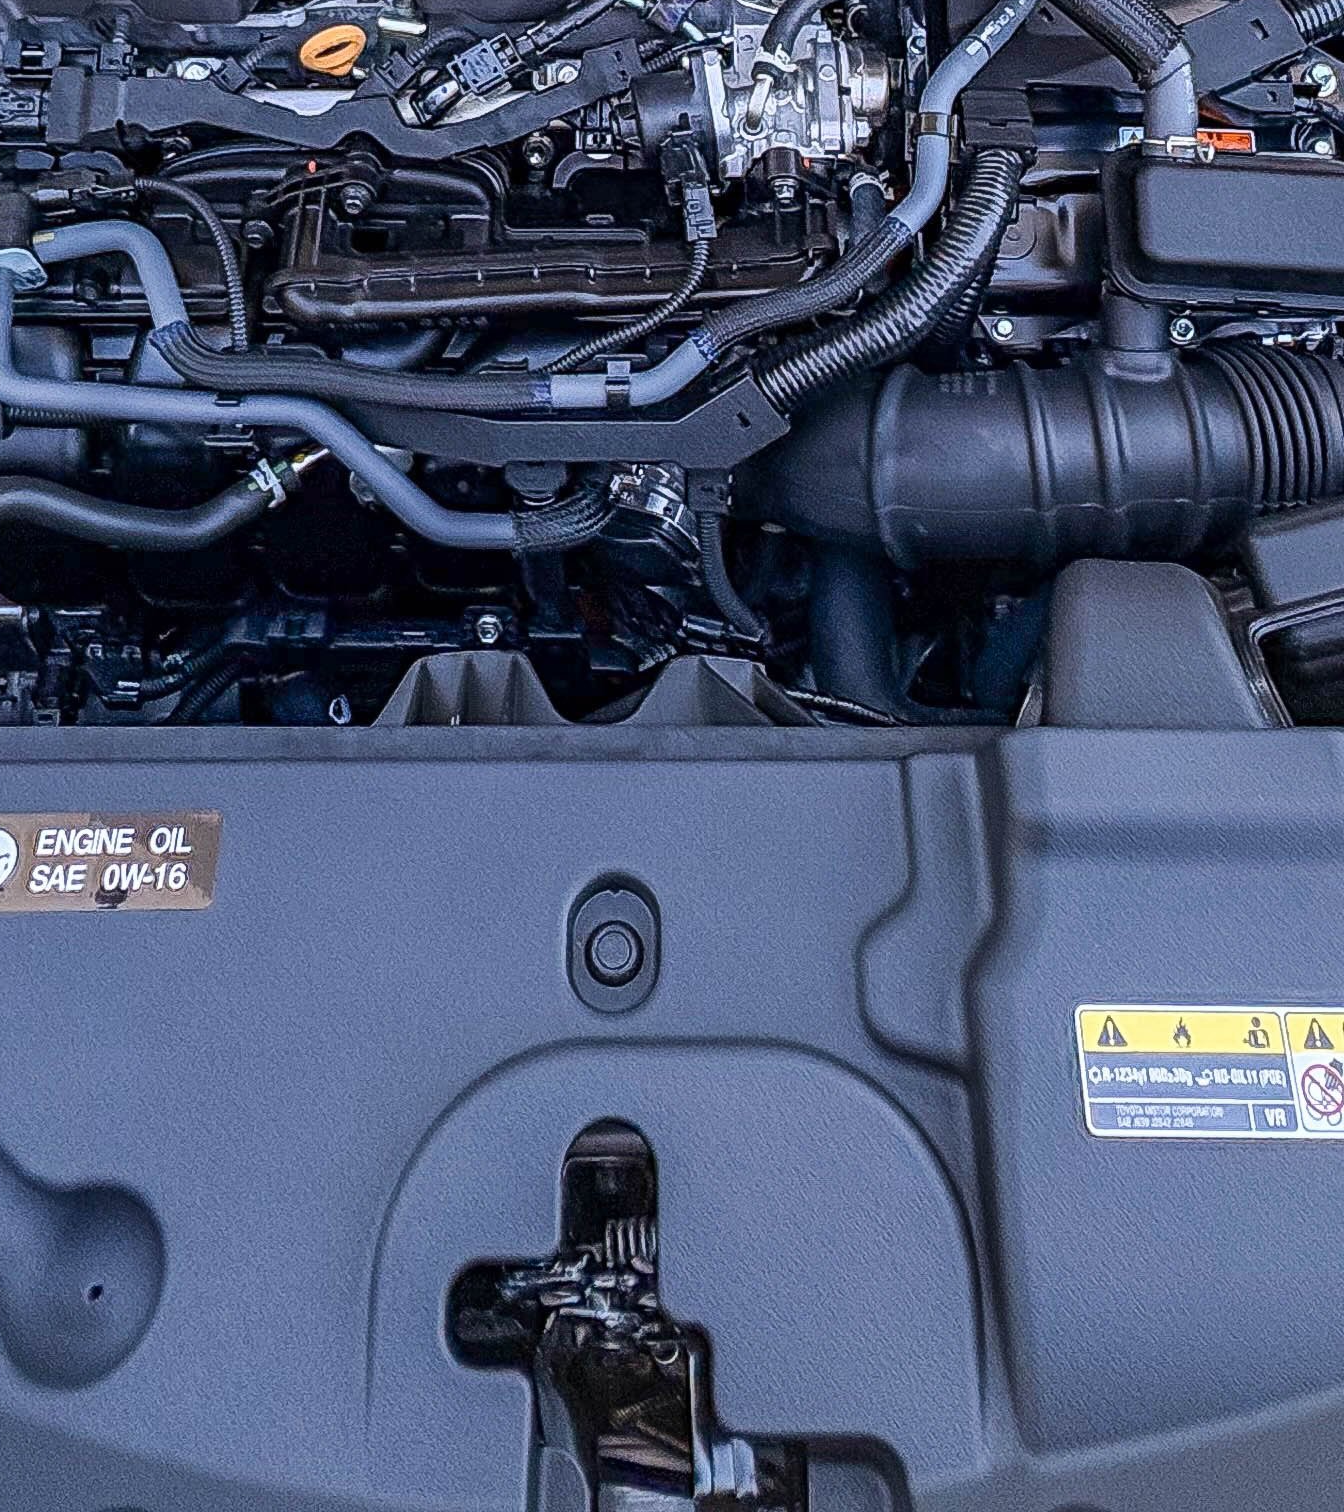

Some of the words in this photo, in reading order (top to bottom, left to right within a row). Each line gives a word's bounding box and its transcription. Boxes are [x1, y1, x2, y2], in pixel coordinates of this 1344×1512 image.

[35, 827, 137, 857] ENGINE
[149, 826, 193, 855] OIL
[29, 863, 89, 893] SAE
[101, 862, 189, 891] 0W-16
[1264, 1107, 1288, 1127] VR
